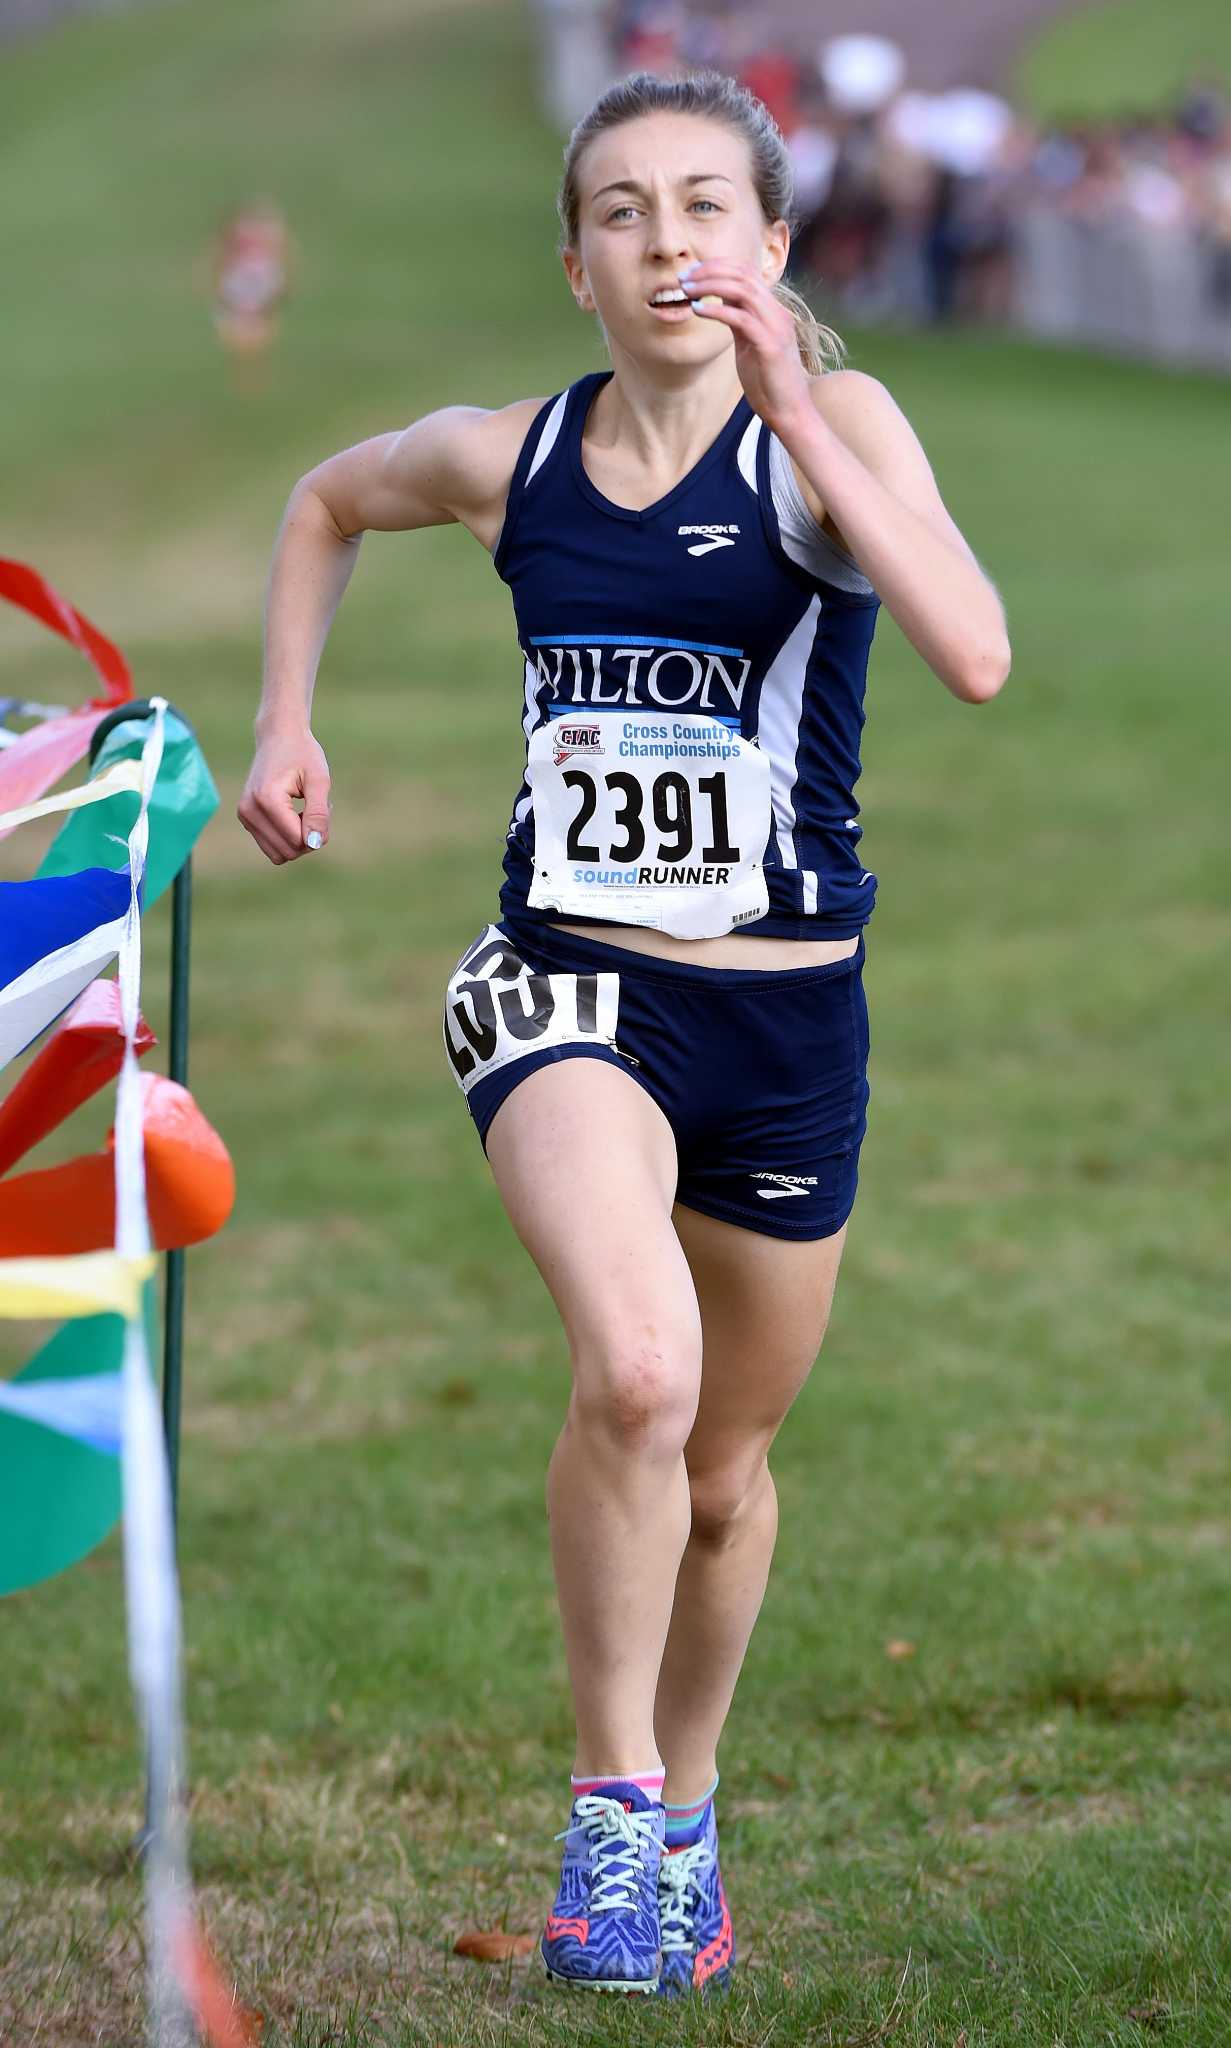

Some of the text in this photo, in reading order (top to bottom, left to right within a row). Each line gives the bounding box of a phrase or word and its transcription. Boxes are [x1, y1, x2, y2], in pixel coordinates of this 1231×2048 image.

[622, 723, 735, 742] Cross Country
[619, 741, 741, 761] Championships
[561, 769, 741, 864] 2391
[573, 866, 730, 886] soundRUNNER
